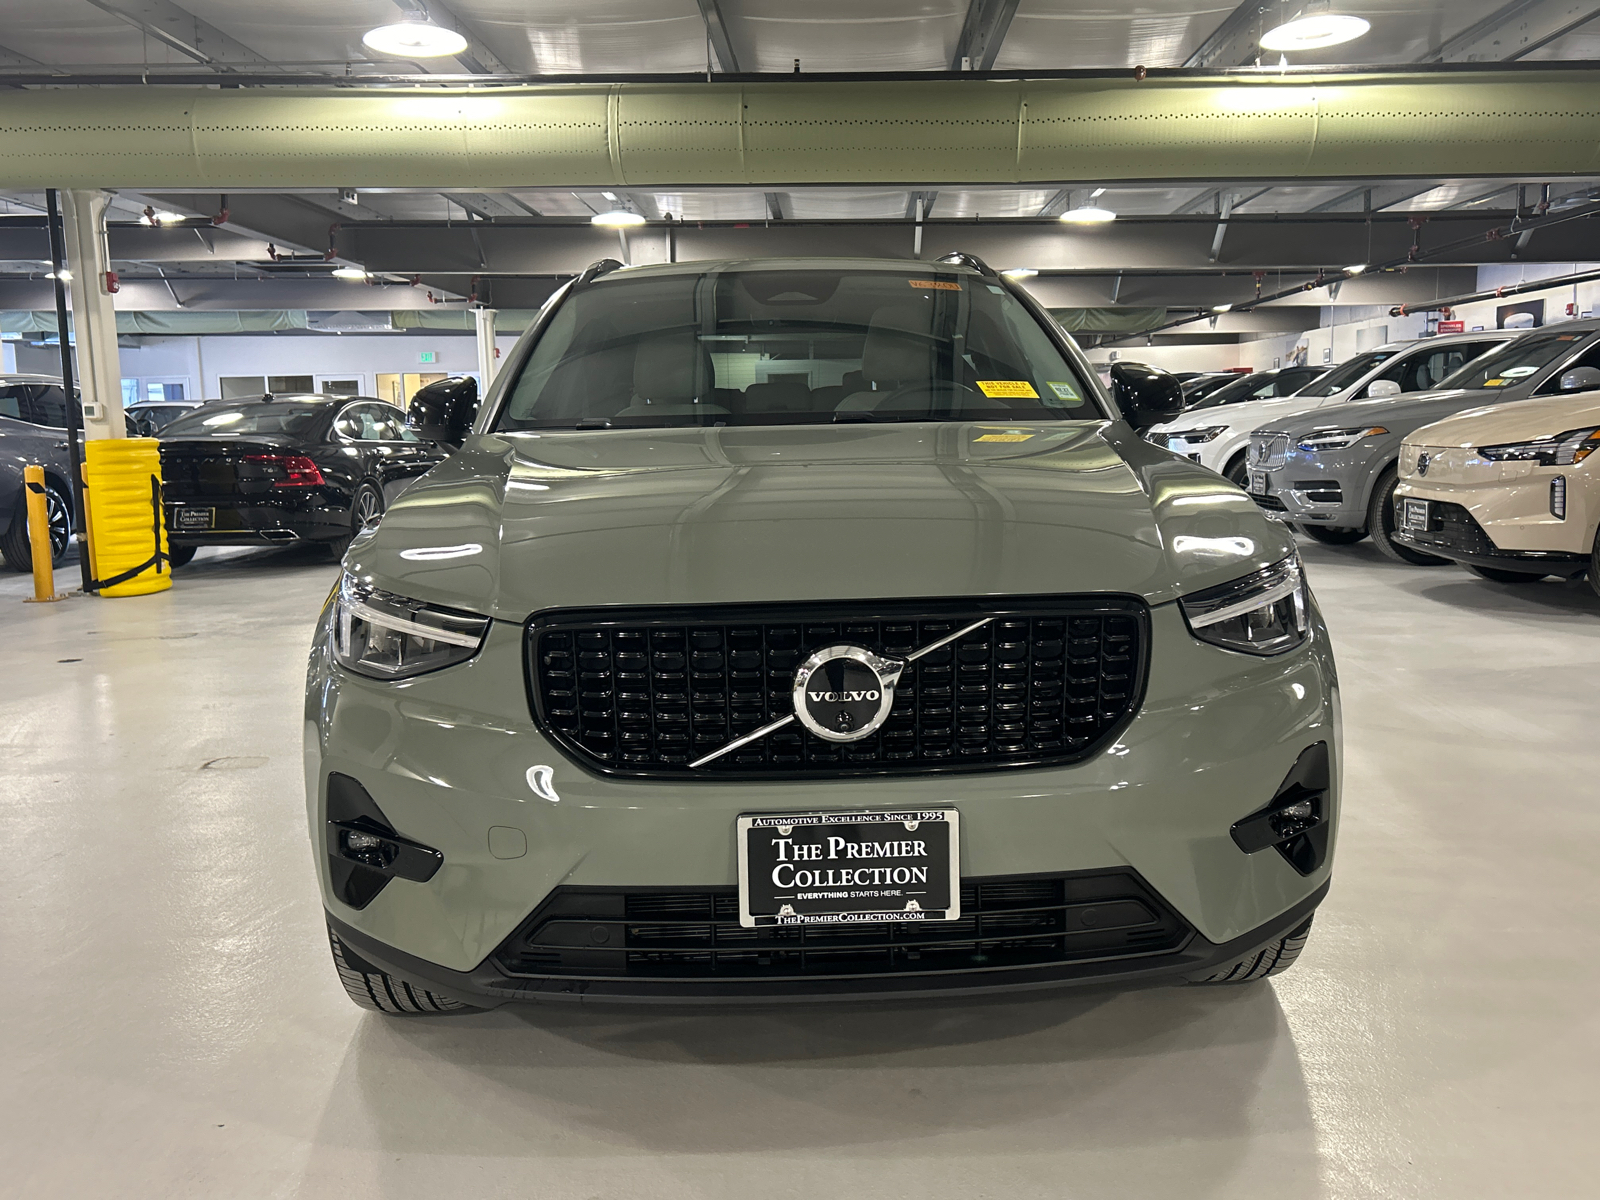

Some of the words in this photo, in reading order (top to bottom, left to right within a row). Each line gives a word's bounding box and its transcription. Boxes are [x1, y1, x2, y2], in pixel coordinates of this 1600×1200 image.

[808, 690, 880, 702] VOLVO
[754, 817, 819, 826] AUTOMOTIVE
[821, 815, 882, 823] EXCELLENCE
[884, 813, 913, 821] SINCE
[917, 812, 943, 820] 1995
[771, 838, 823, 861] THE
[827, 836, 928, 859] PREMIER
[772, 863, 928, 888] COLLECTION
[797, 891, 849, 900] EVERYTHING
[850, 890, 879, 898] STARTS
